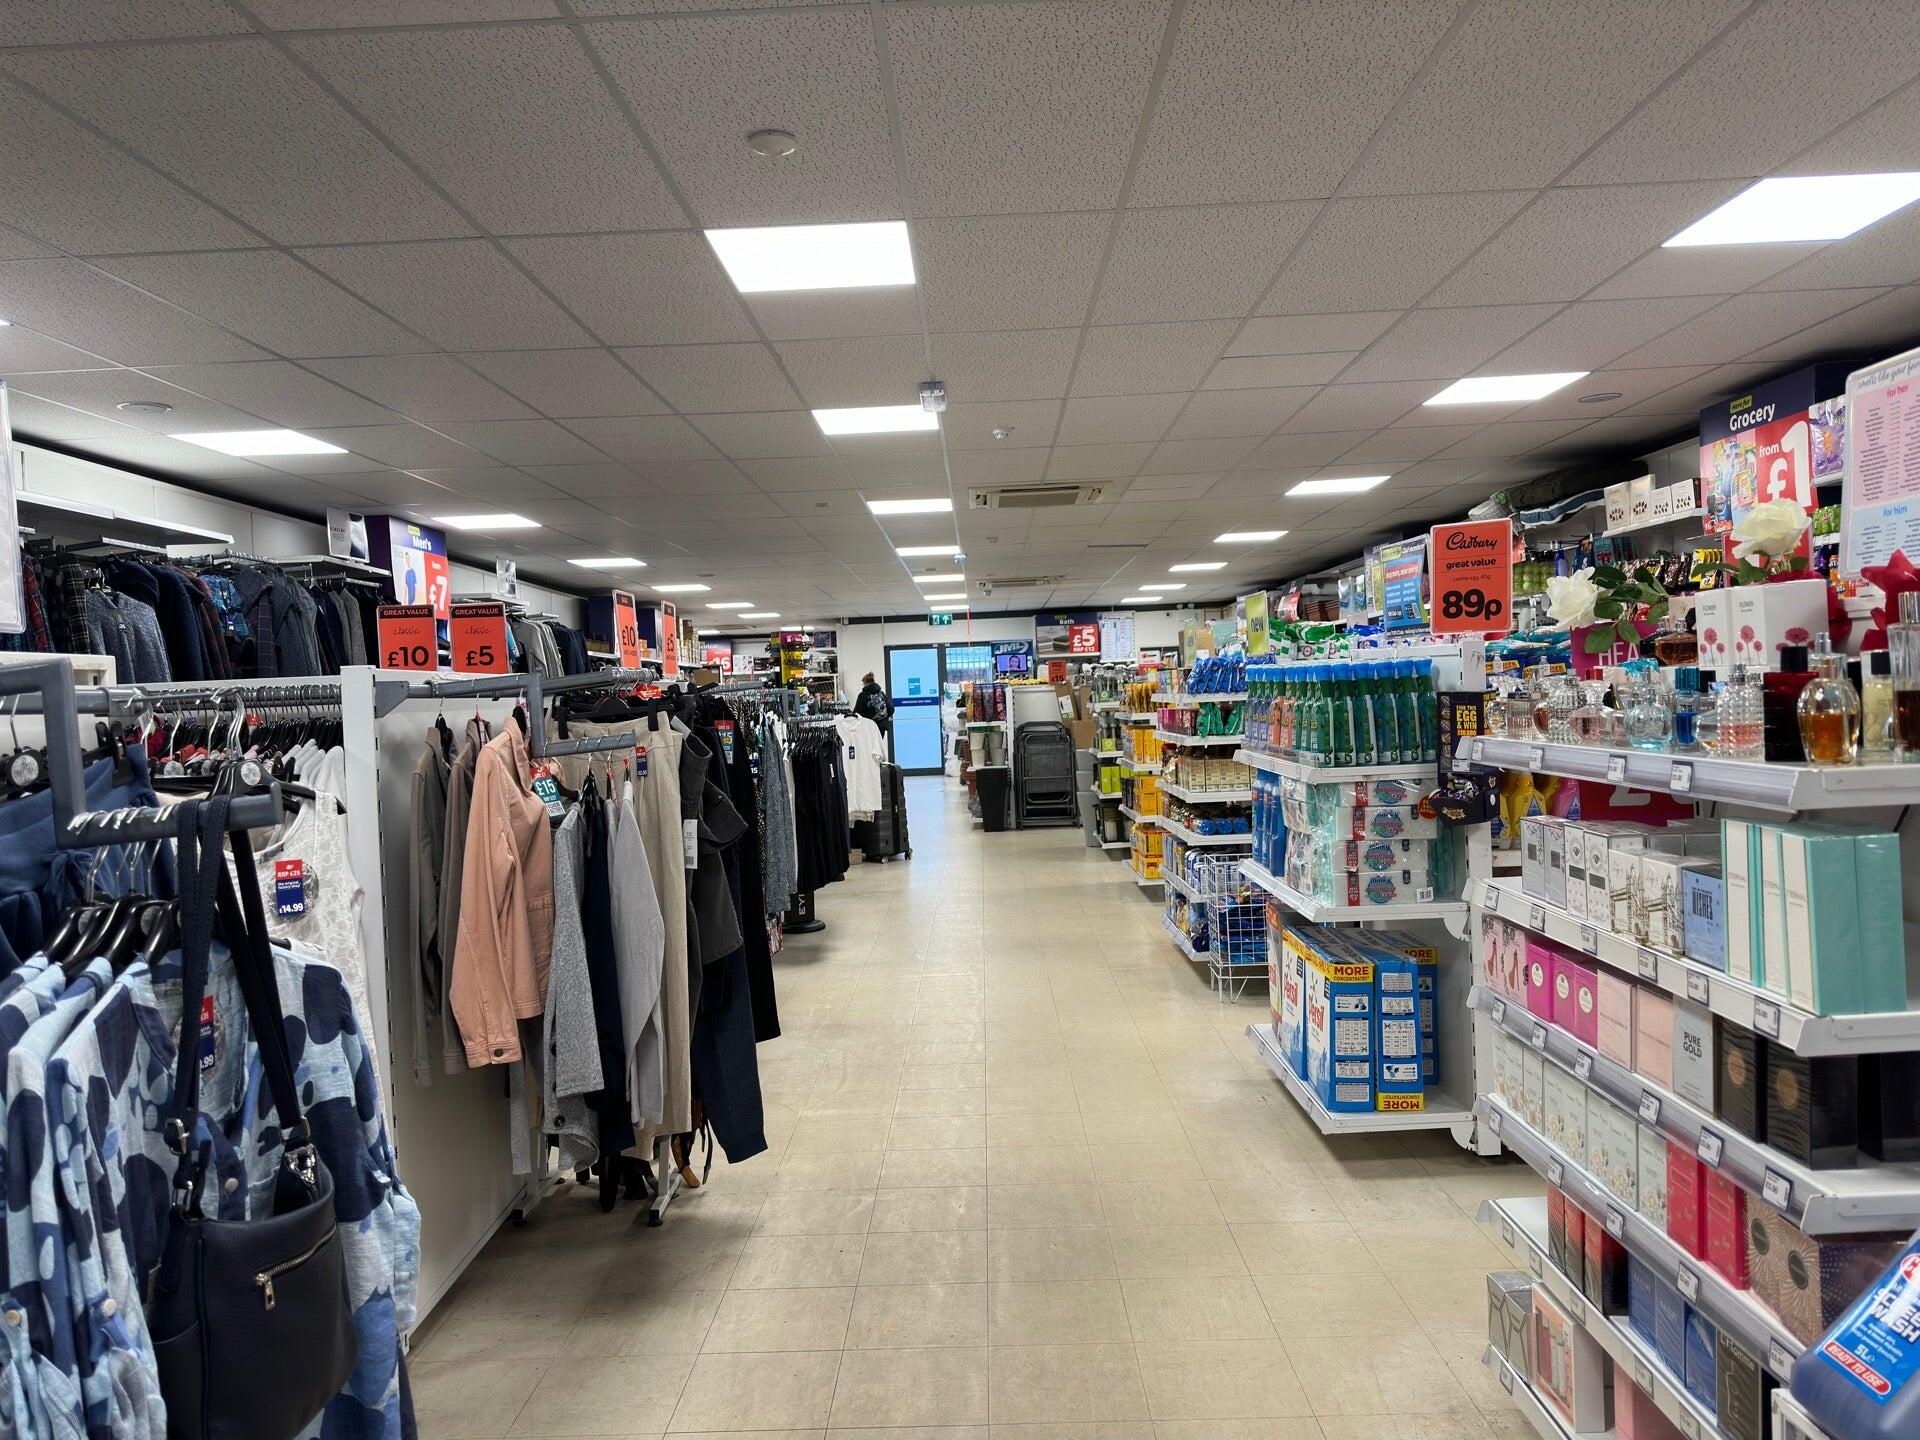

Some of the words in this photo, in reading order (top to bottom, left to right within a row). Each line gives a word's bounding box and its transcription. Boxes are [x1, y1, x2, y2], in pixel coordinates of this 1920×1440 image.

[1891, 365, 1905, 382] your
[1730, 403, 1776, 431] Grocery
[1759, 443, 1780, 458] from
[1767, 420, 1812, 507] £1
[412, 535, 432, 550] Men's
[1446, 532, 1498, 550] Cadbury
[1446, 561, 1470, 570] great
[1471, 558, 1496, 567] value
[429, 576, 448, 611] £7
[1442, 588, 1502, 620] 89p
[393, 626, 421, 635] classic
[464, 626, 492, 635] classic
[622, 626, 636, 647] £10
[1072, 629, 1096, 647] £5
[667, 633, 675, 652] £5
[997, 642, 1023, 654] JML
[388, 646, 429, 667] £10
[466, 646, 495, 666] £5
[1456, 710, 1477, 721] EGG
[1456, 721, 1462, 729] &
[1463, 721, 1477, 730] WIN
[535, 779, 556, 796] £15
[289, 869, 301, 877] £25
[279, 903, 303, 913] £14.99
[1334, 966, 1369, 975] MORE
[1283, 974, 1298, 1007] Persil
[1308, 993, 1325, 1032] Persil
[1683, 1031, 1701, 1047] PURE
[1683, 1042, 1702, 1058] GOLD
[1383, 1101, 1420, 1109] MORE
[1828, 1344, 1856, 1368] READY
[1852, 1362, 1866, 1375] TO
[1862, 1370, 1884, 1389] USE
